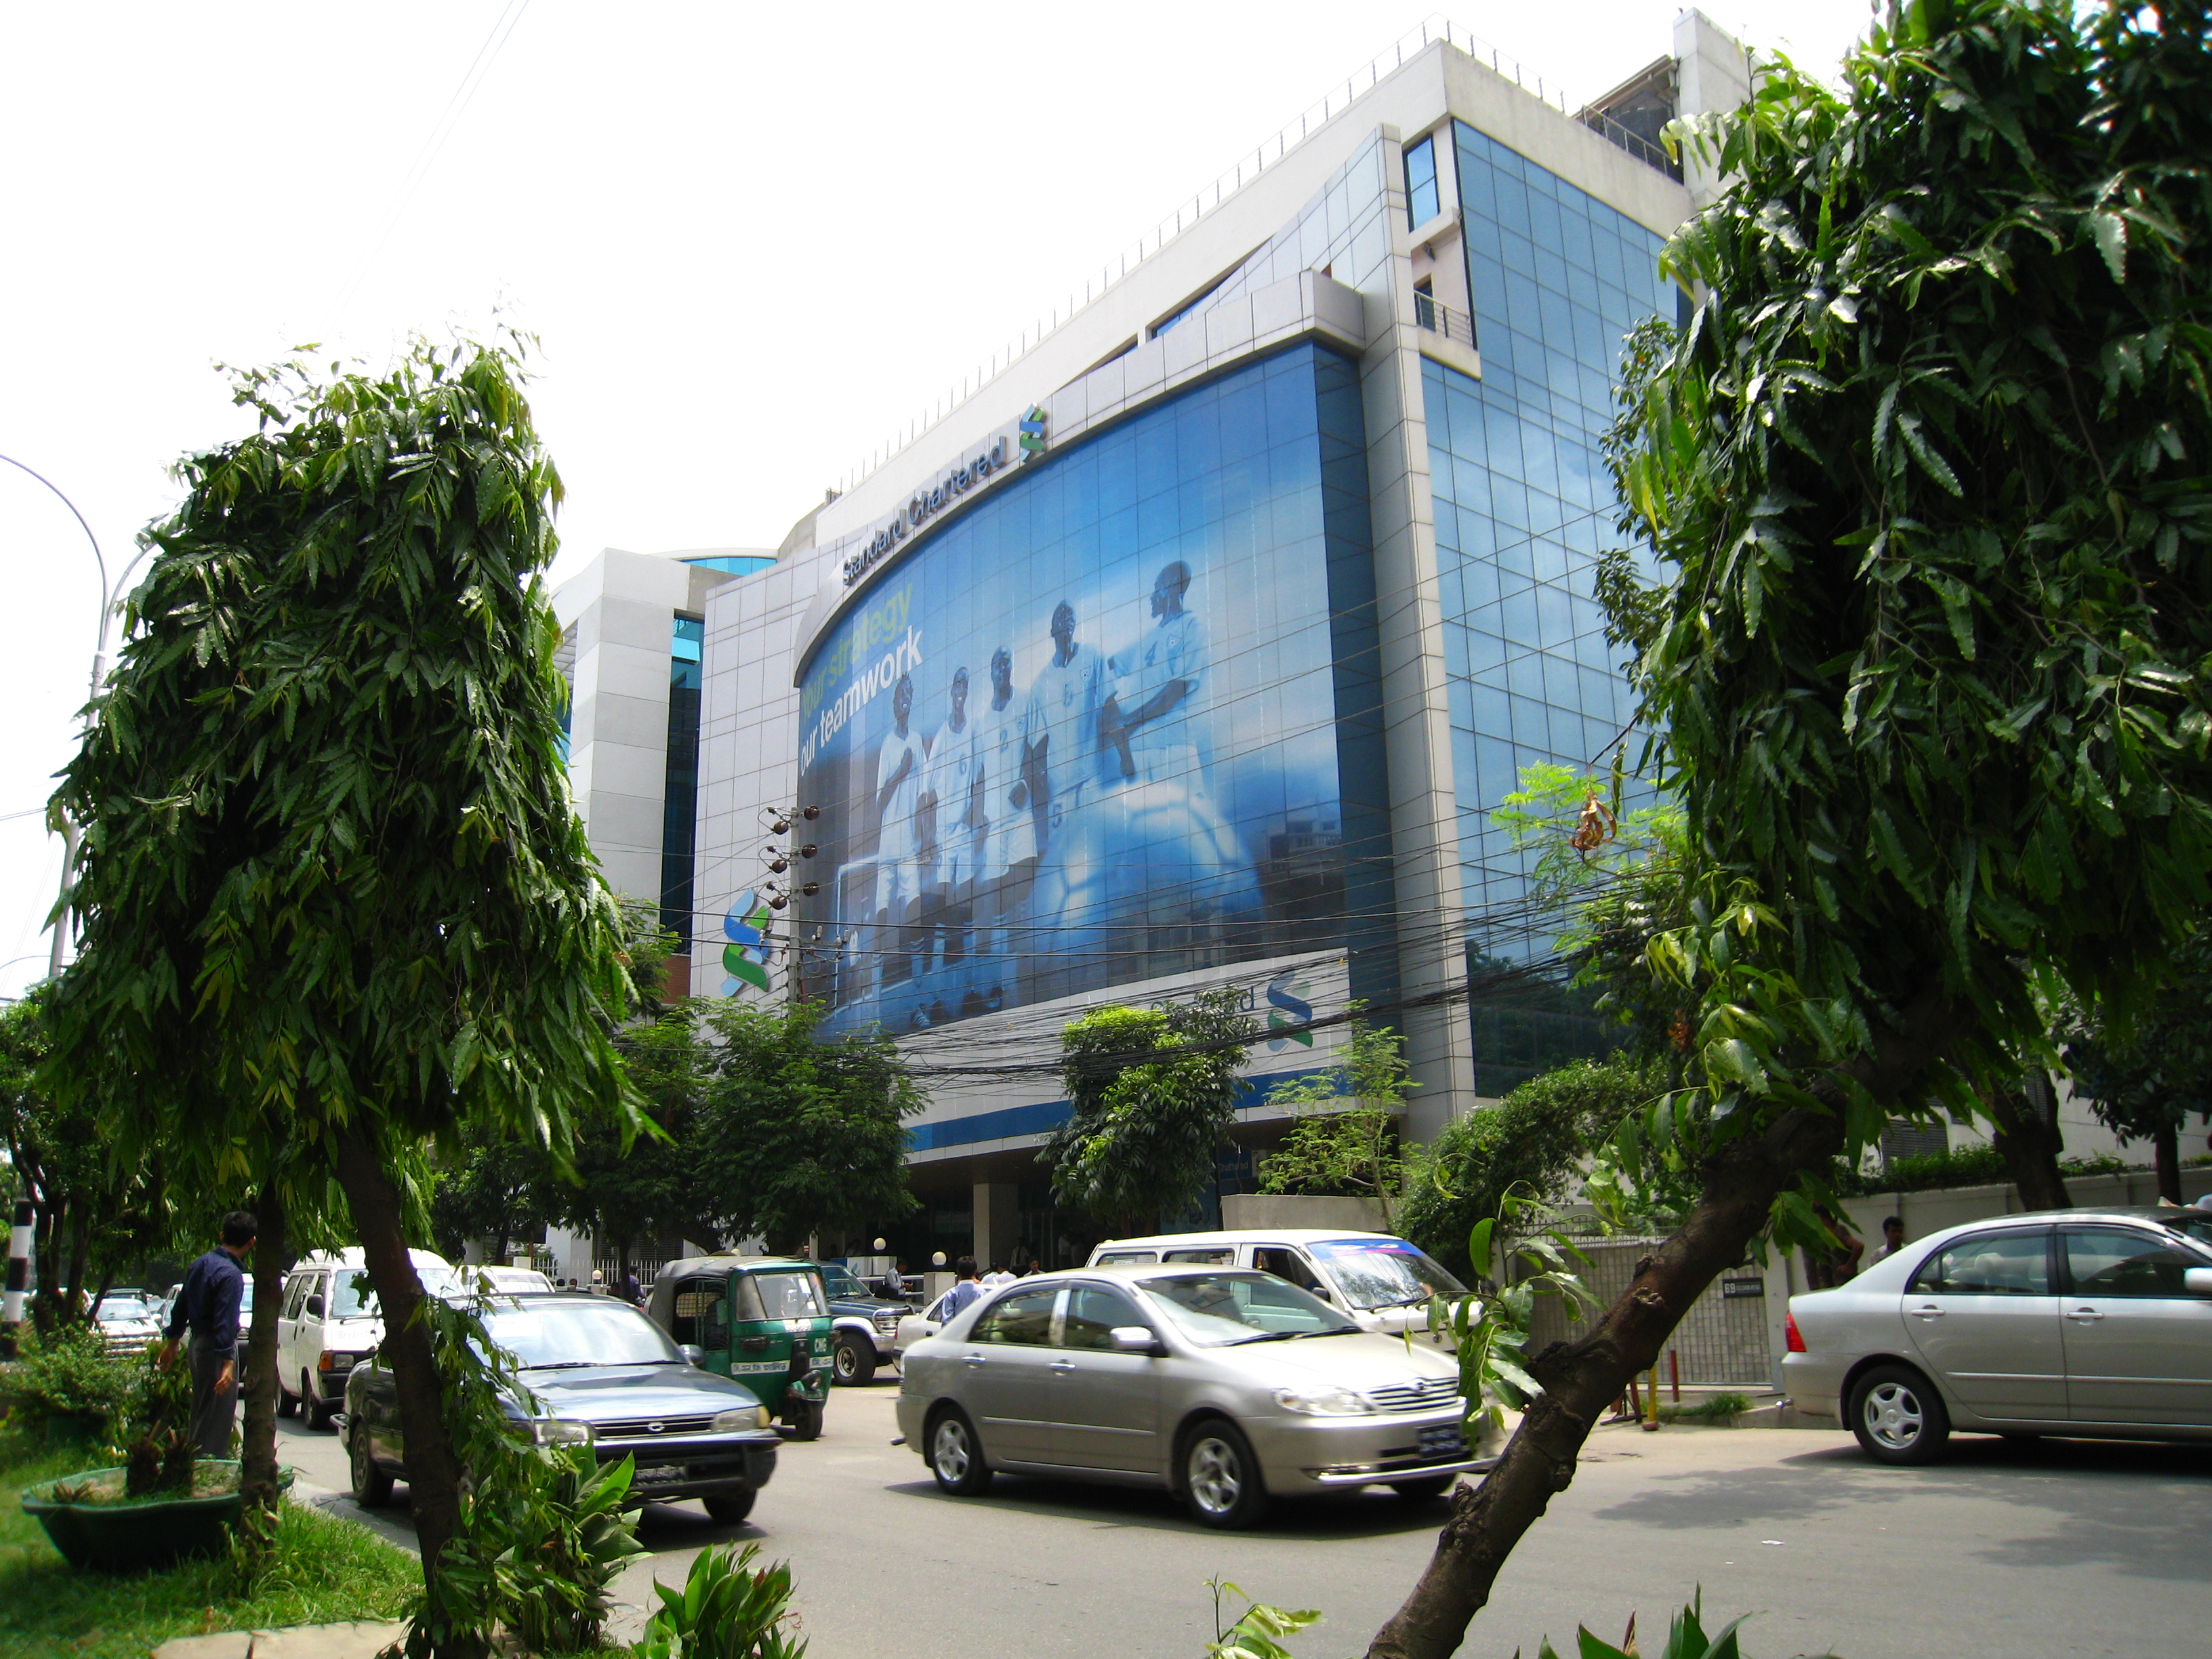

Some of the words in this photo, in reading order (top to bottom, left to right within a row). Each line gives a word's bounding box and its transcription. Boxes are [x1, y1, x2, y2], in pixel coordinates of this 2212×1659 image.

[842, 508, 906, 586] Standard
[907, 435, 1007, 526] Chartered
[801, 724, 819, 777] our
[819, 624, 923, 748] teamwork
[802, 665, 827, 725] your
[828, 581, 914, 687] strategy
